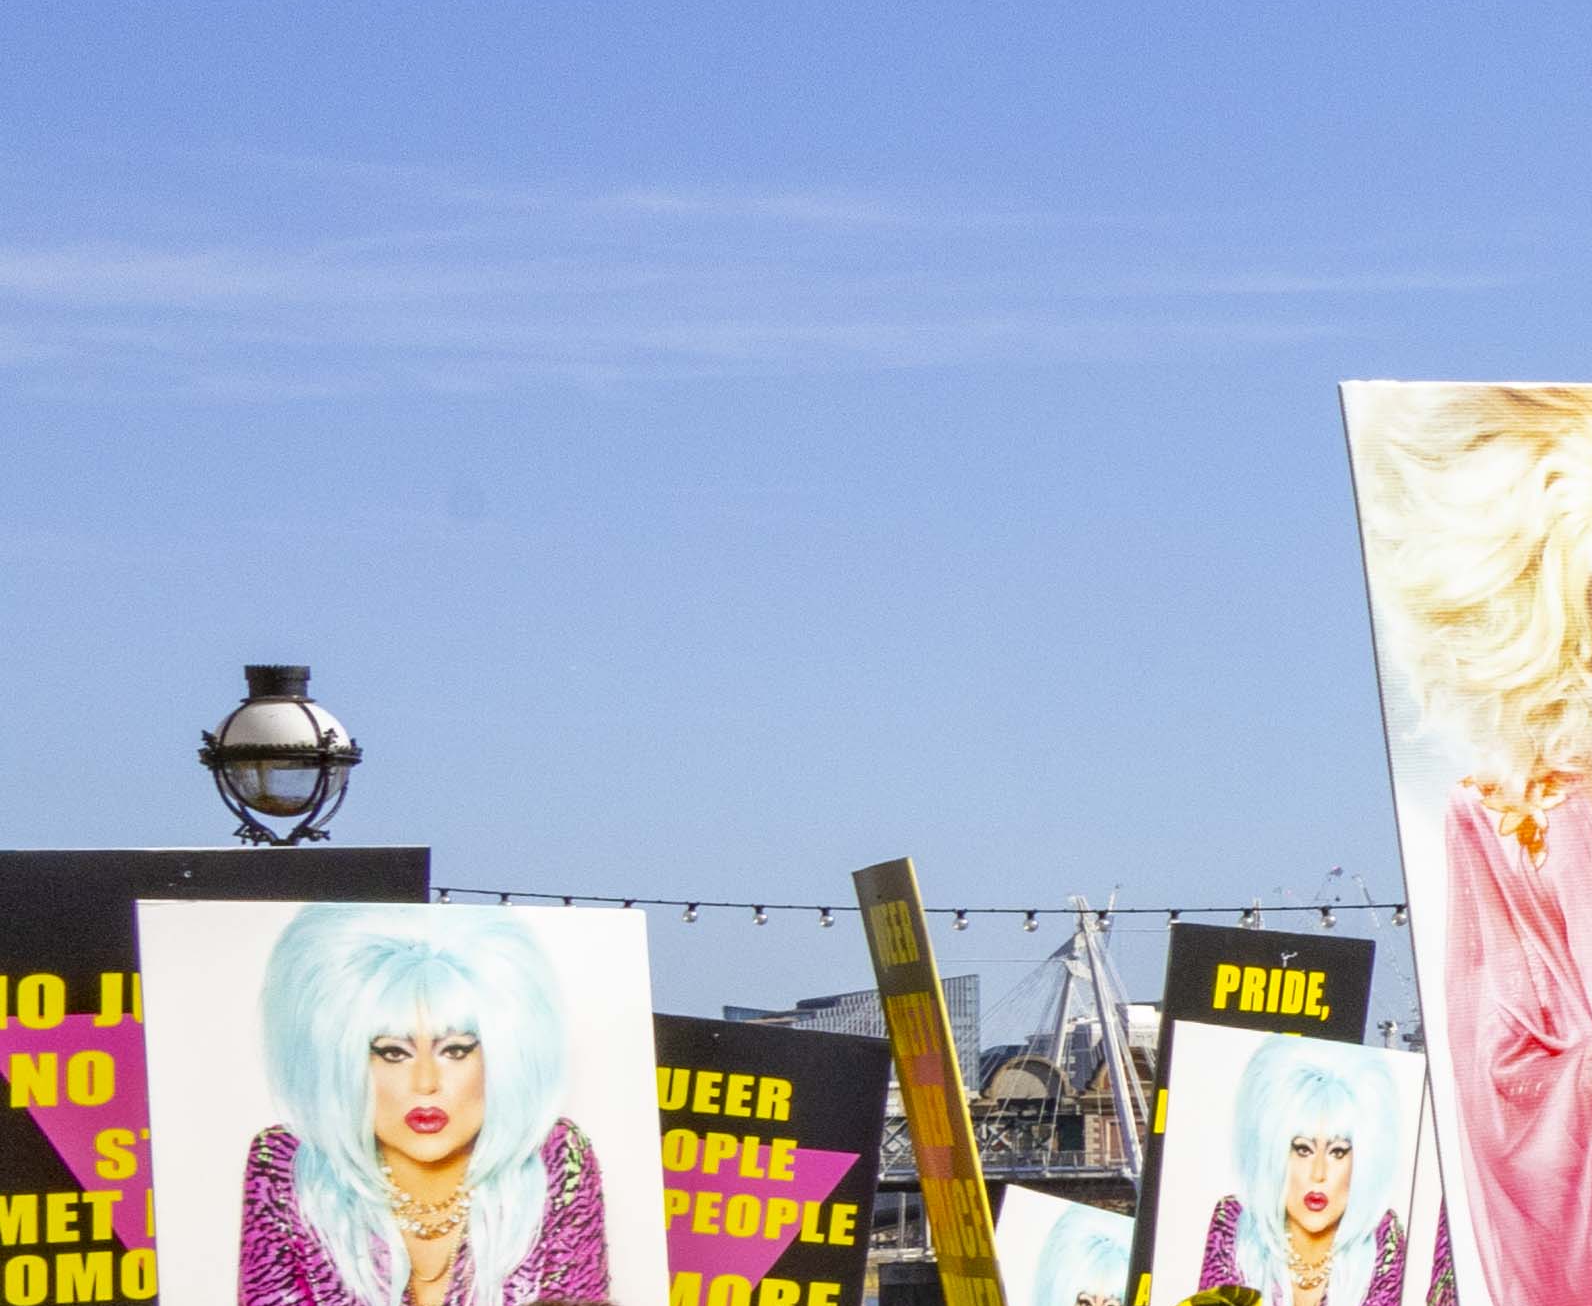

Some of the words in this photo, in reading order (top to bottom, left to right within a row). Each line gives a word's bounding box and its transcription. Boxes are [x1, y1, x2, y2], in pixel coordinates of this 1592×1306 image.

[0, 972, 65, 1028] O
[1212, 963, 1329, 1021] PRIDE,
[9, 1050, 115, 1109] NO
[94, 1128, 150, 1181] S
[921, 1178, 991, 1261] PLICE
